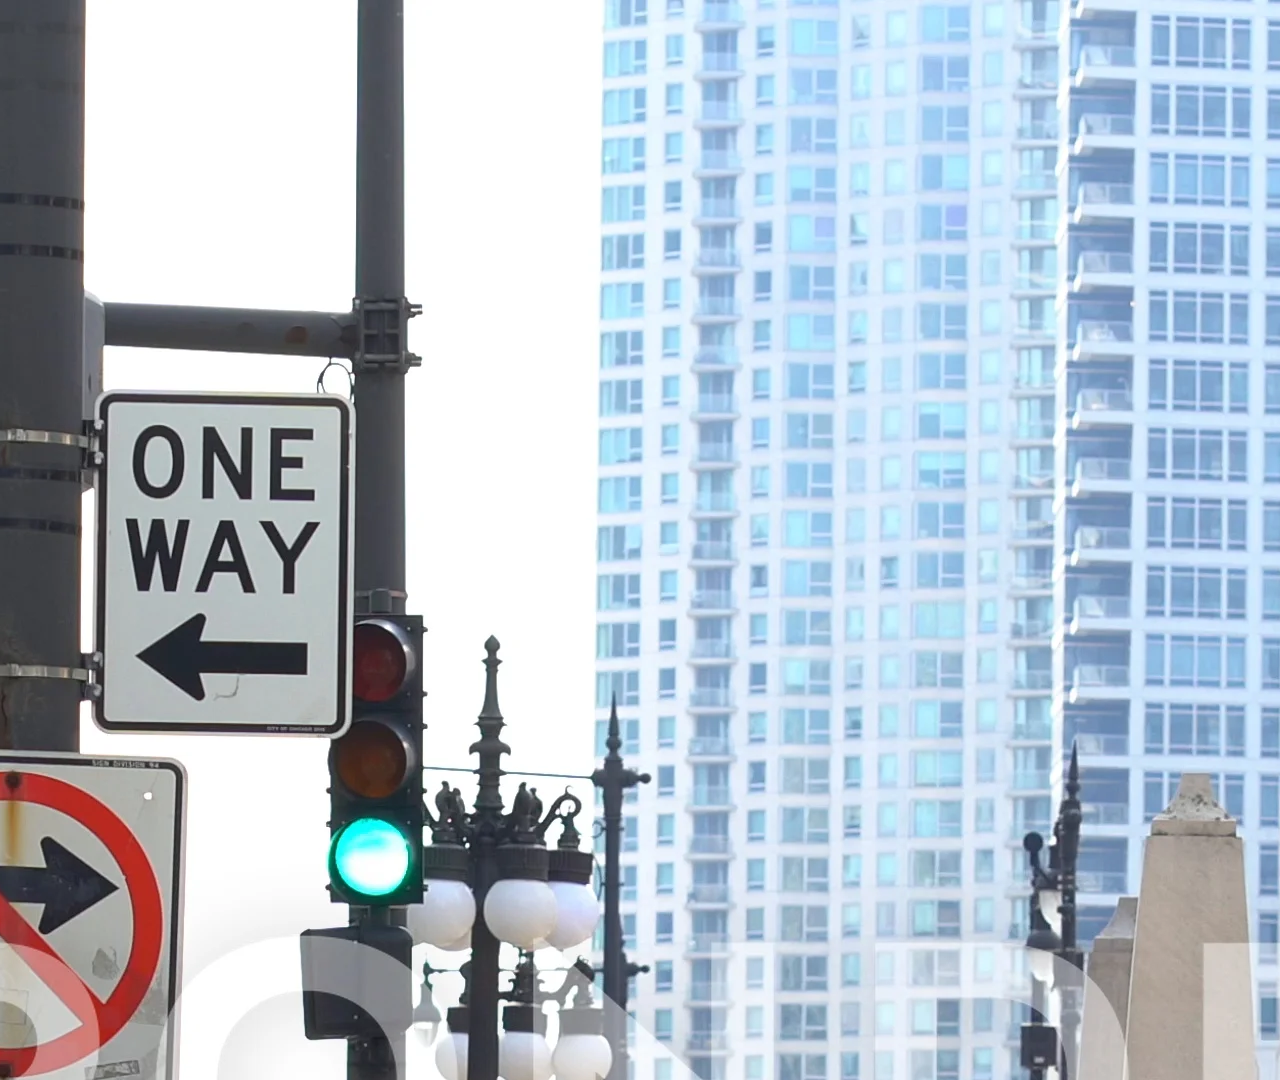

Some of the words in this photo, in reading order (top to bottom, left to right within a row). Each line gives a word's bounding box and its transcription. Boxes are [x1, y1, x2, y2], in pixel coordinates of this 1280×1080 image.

[132, 424, 316, 502] ONE
[125, 518, 321, 594] WAY
[113, 759, 146, 768] DIVISION
